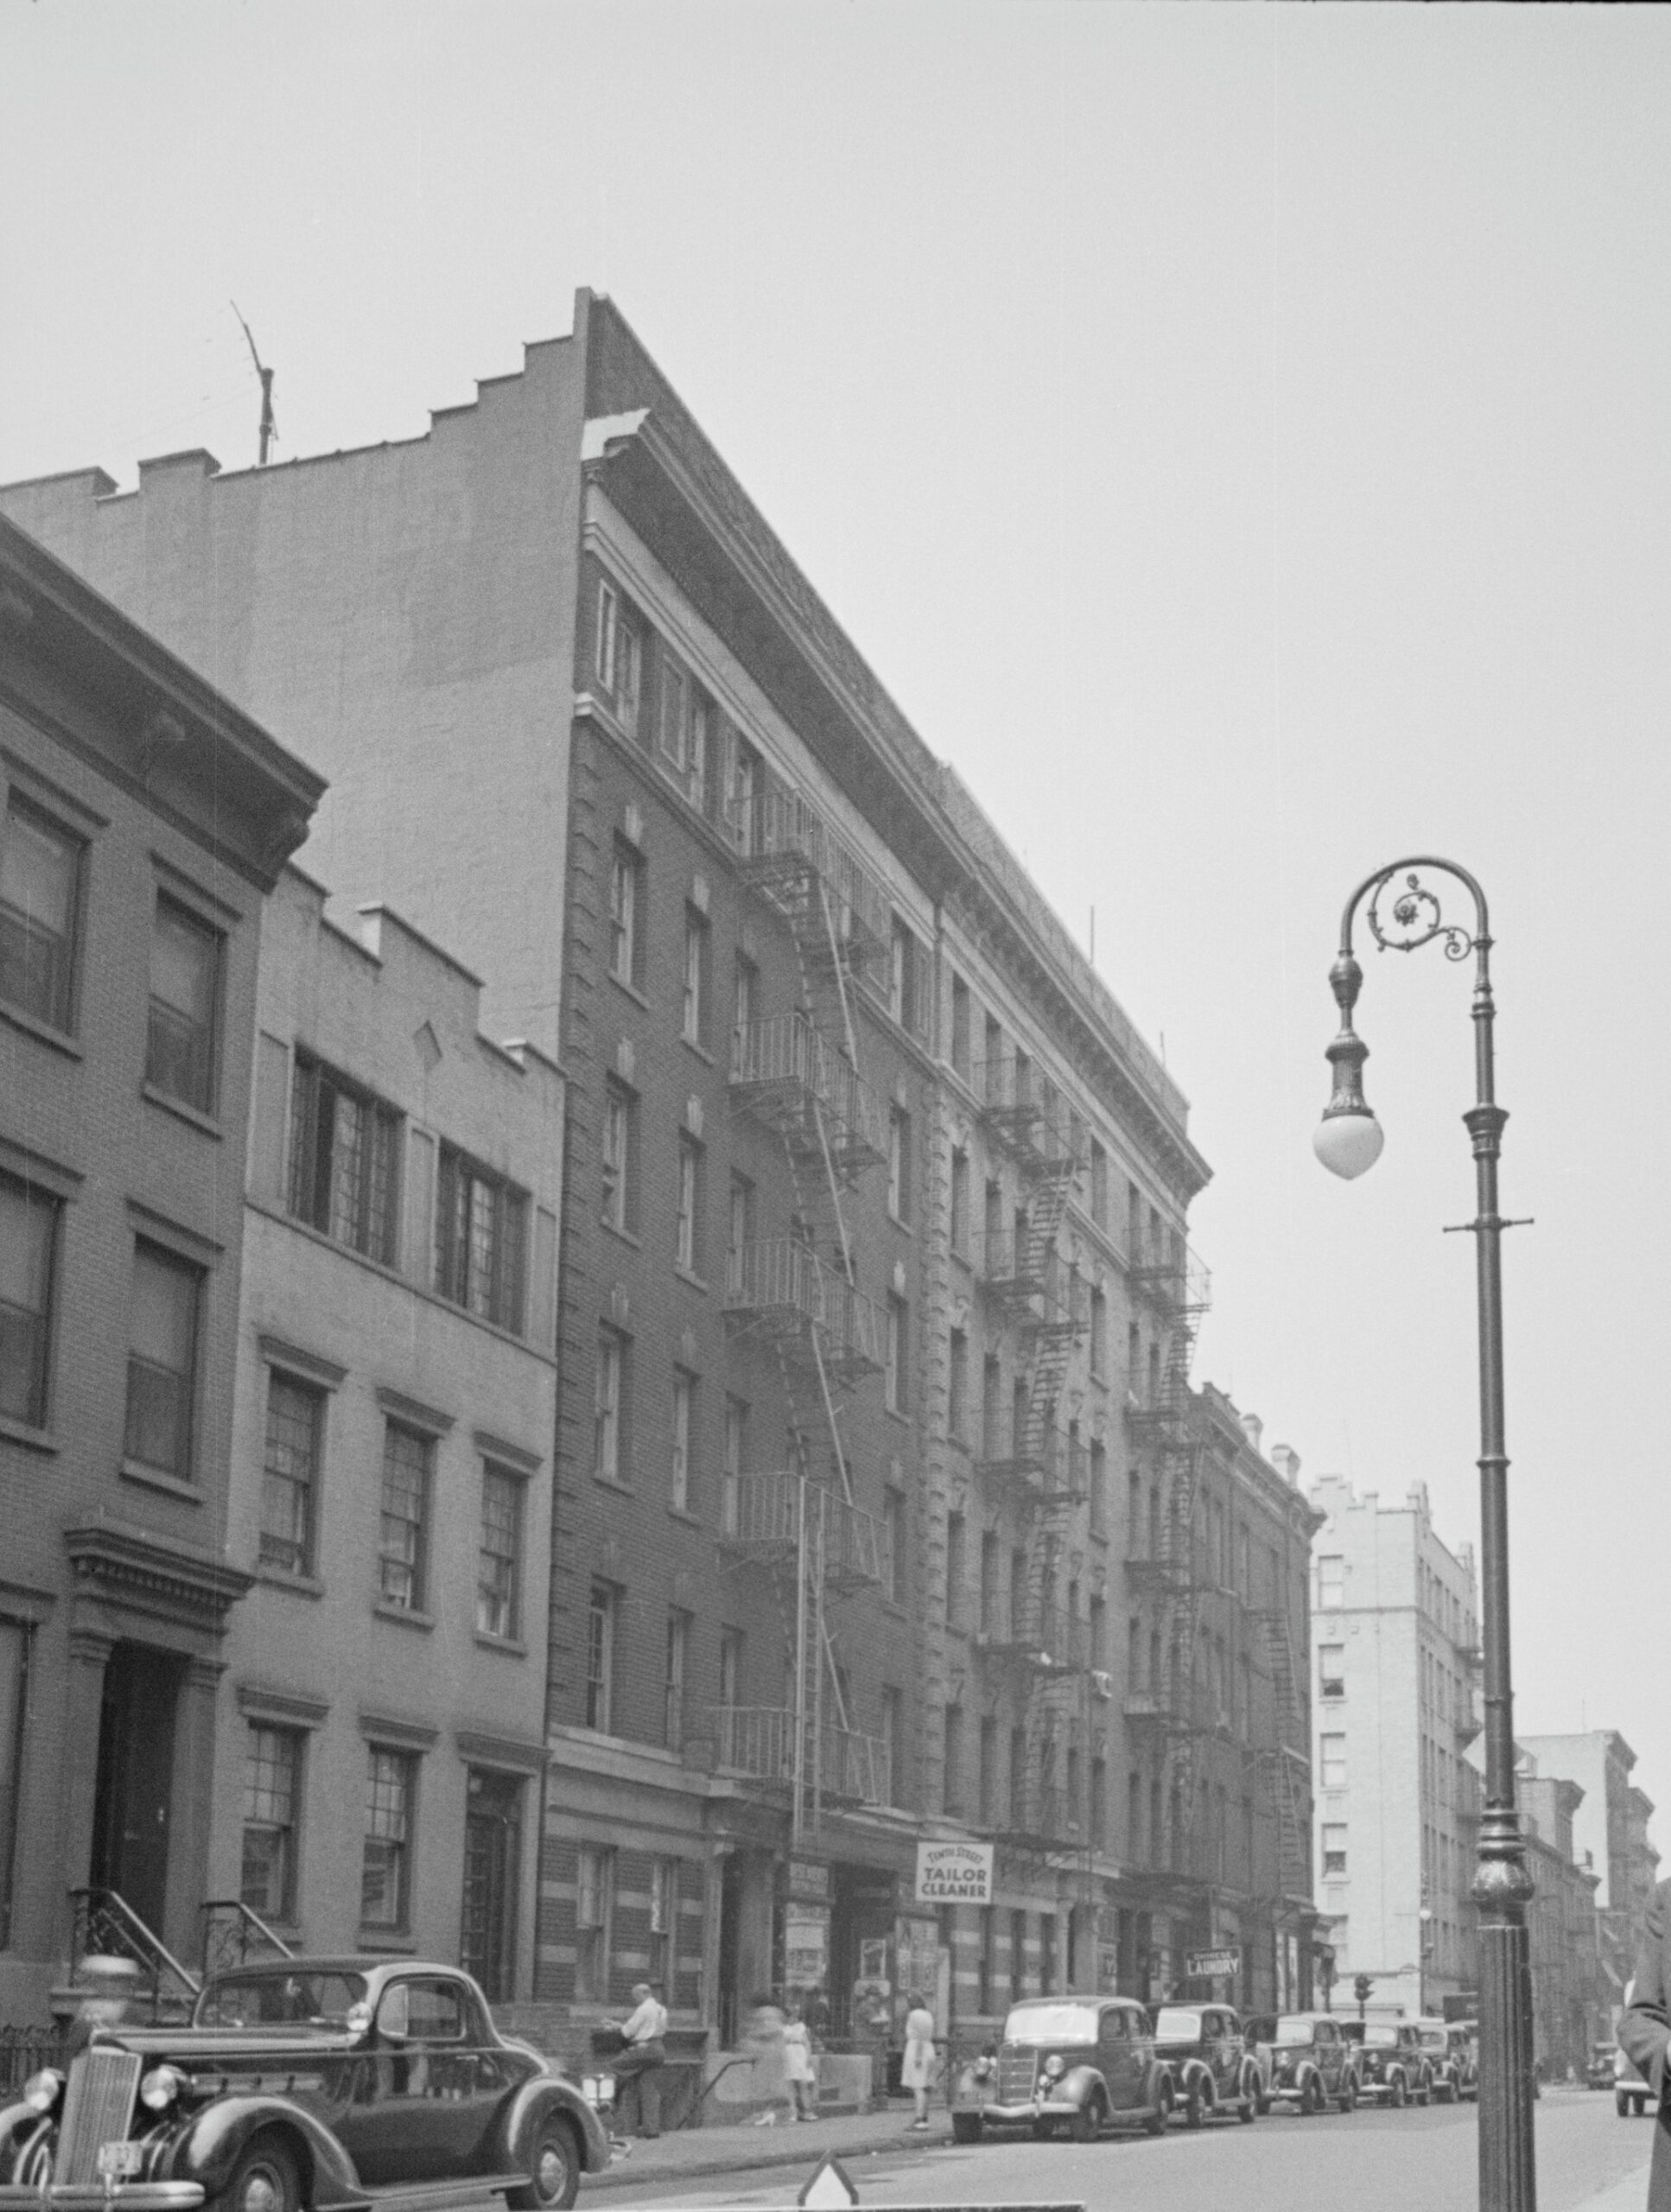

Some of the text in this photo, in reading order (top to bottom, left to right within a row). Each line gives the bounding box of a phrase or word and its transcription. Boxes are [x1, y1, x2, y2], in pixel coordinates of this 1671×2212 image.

[924, 1868, 987, 1882] TAILOR
[921, 1883, 986, 1897] CLEANER
[1186, 1958, 1238, 1976] LAUNDRY
